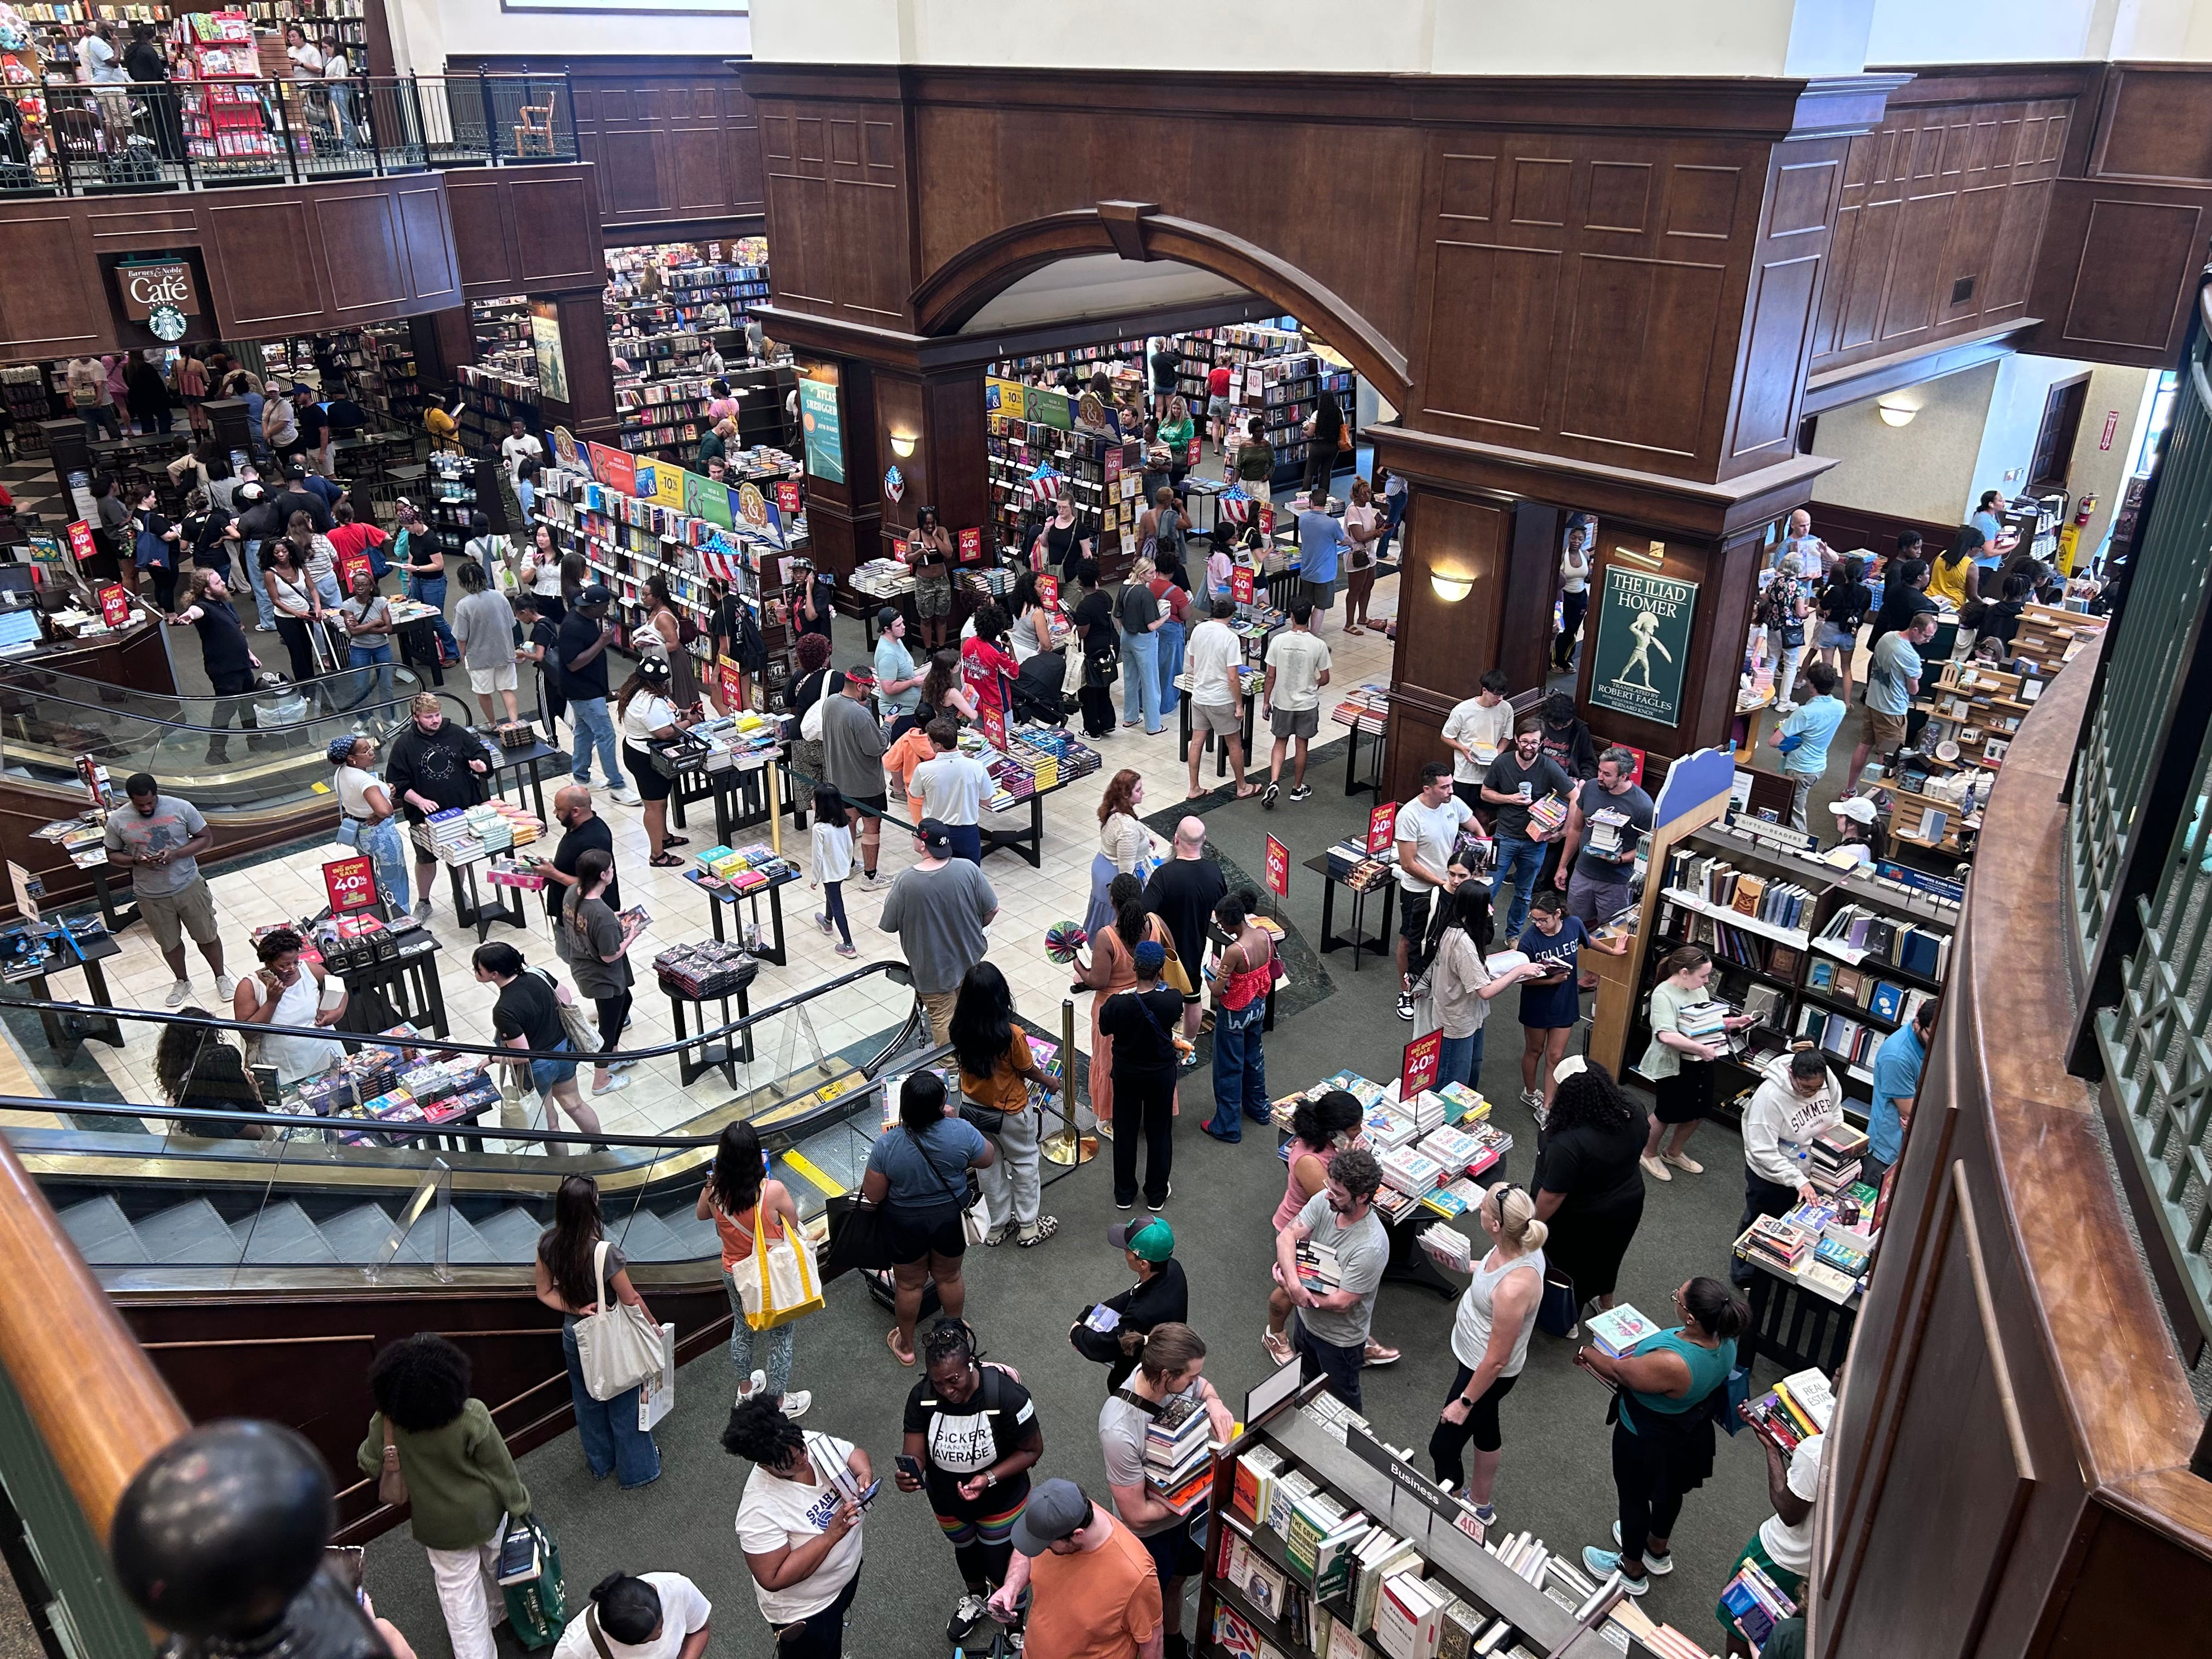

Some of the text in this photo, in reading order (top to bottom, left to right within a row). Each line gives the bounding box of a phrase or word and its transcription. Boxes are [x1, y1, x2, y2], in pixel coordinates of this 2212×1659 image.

[154, 267, 161, 278] &
[130, 276, 189, 303] Café
[816, 389, 836, 403] ATLAS
[806, 399, 837, 416] SHRUGGED
[74, 534, 89, 545] 40%
[962, 539, 978, 548] 40%
[1235, 578, 1250, 589] 40%
[1613, 573, 1686, 601] THE ILIAD
[105, 598, 123, 610] 40%
[1618, 592, 1677, 618] HOMER
[1612, 682, 1650, 696] TRANSLATED
[1598, 684, 1673, 711] ROBERT FAGLES
[1611, 701, 1637, 712] BERNARD
[986, 718, 1002, 731] 40%
[1372, 819, 1391, 833] 40%
[1741, 819, 1761, 830] GIFTS
[1770, 828, 1801, 843] READERS
[345, 862, 364, 871] BOOK
[1268, 855, 1283, 871] 40%
[339, 869, 358, 877] SALE
[1914, 873, 1935, 884] MEMBERS
[334, 875, 367, 891] 40%
[1421, 1038, 1437, 1049] BOOK
[1415, 1046, 1431, 1058] SALE
[1408, 1053, 1435, 1074] 40%
[1449, 1137, 1468, 1149] SAMIN
[1454, 1140, 1474, 1154] NOSRAT
[1406, 1158, 1425, 1170] SAMIN
[1411, 1160, 1433, 1175] NOSRAT
[1803, 1383, 1825, 1396] REAL
[937, 1429, 987, 1443] SICKER
[936, 1441, 960, 1450] THAN
[934, 1446, 990, 1462] AVERAGE
[1391, 1463, 1439, 1505] Business
[1293, 1516, 1302, 1530] THE
[1460, 1516, 1483, 1537] 40%
[1319, 1574, 1341, 1588] MONEY
[1389, 1606, 1405, 1624] BASIC
[1381, 1607, 1412, 1642] ECONOMICS
